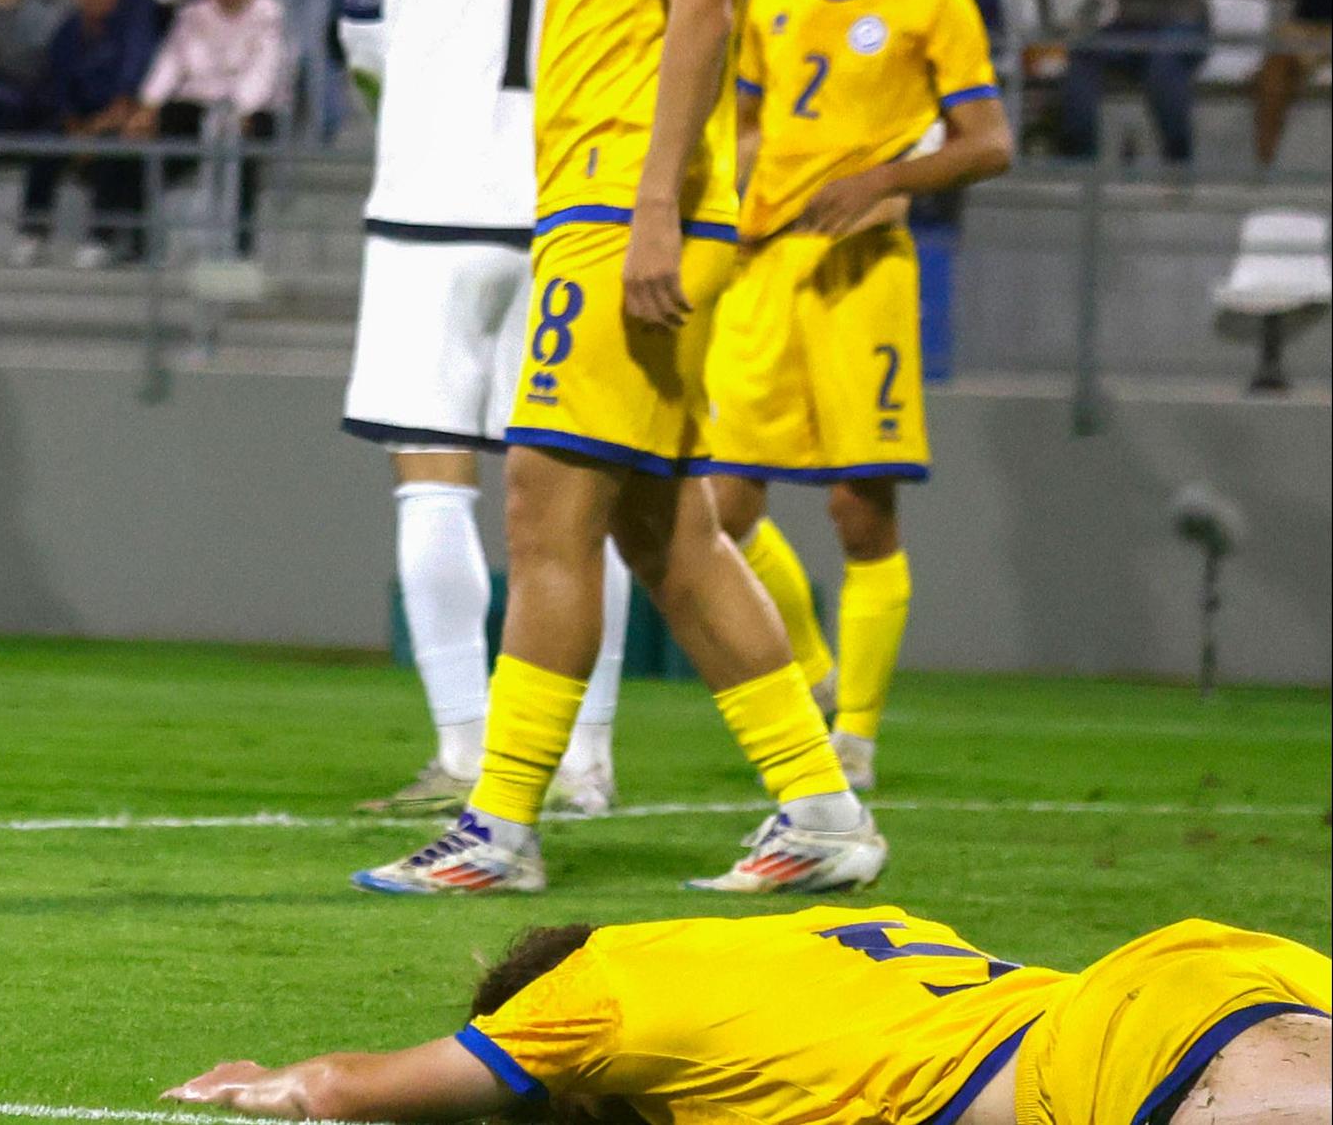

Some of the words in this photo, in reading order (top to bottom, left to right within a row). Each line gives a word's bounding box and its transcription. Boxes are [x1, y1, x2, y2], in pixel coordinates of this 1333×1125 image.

[792, 52, 831, 119] 2
[532, 277, 585, 366] 8
[873, 343, 903, 410] 2
